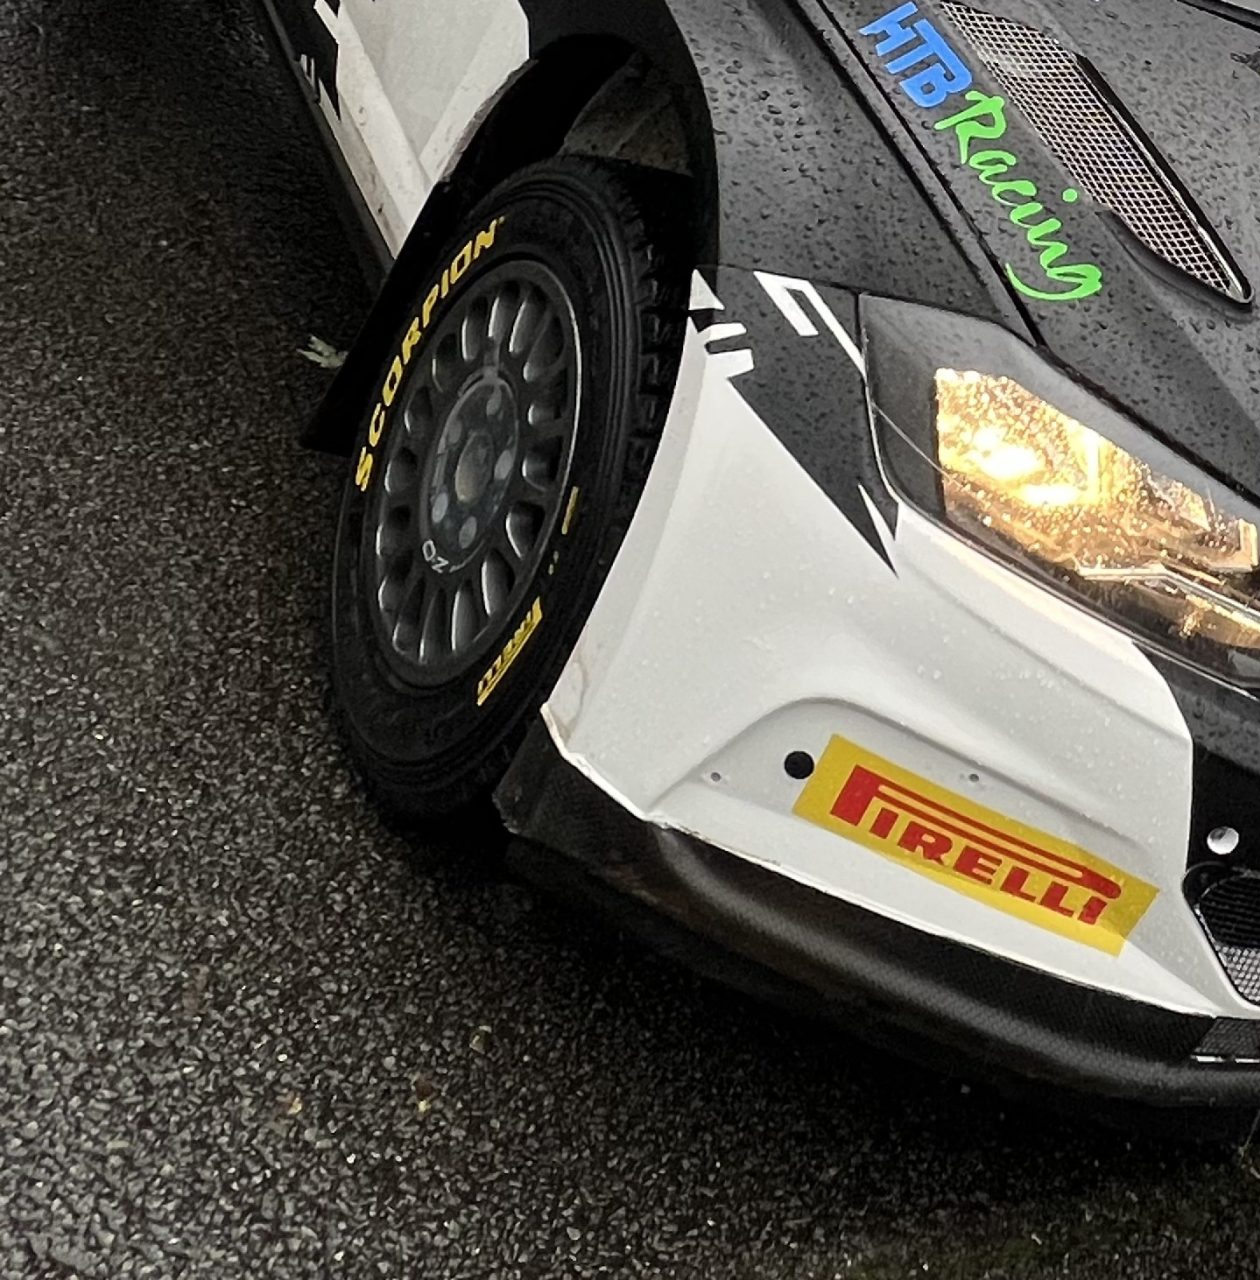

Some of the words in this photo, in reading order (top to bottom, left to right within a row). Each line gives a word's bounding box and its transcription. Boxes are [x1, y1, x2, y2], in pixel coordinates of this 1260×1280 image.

[859, 0, 972, 108] HTB
[933, 90, 1102, 300] Racing
[354, 225, 498, 492] SCORPION
[830, 764, 1121, 925] PIRELLI
